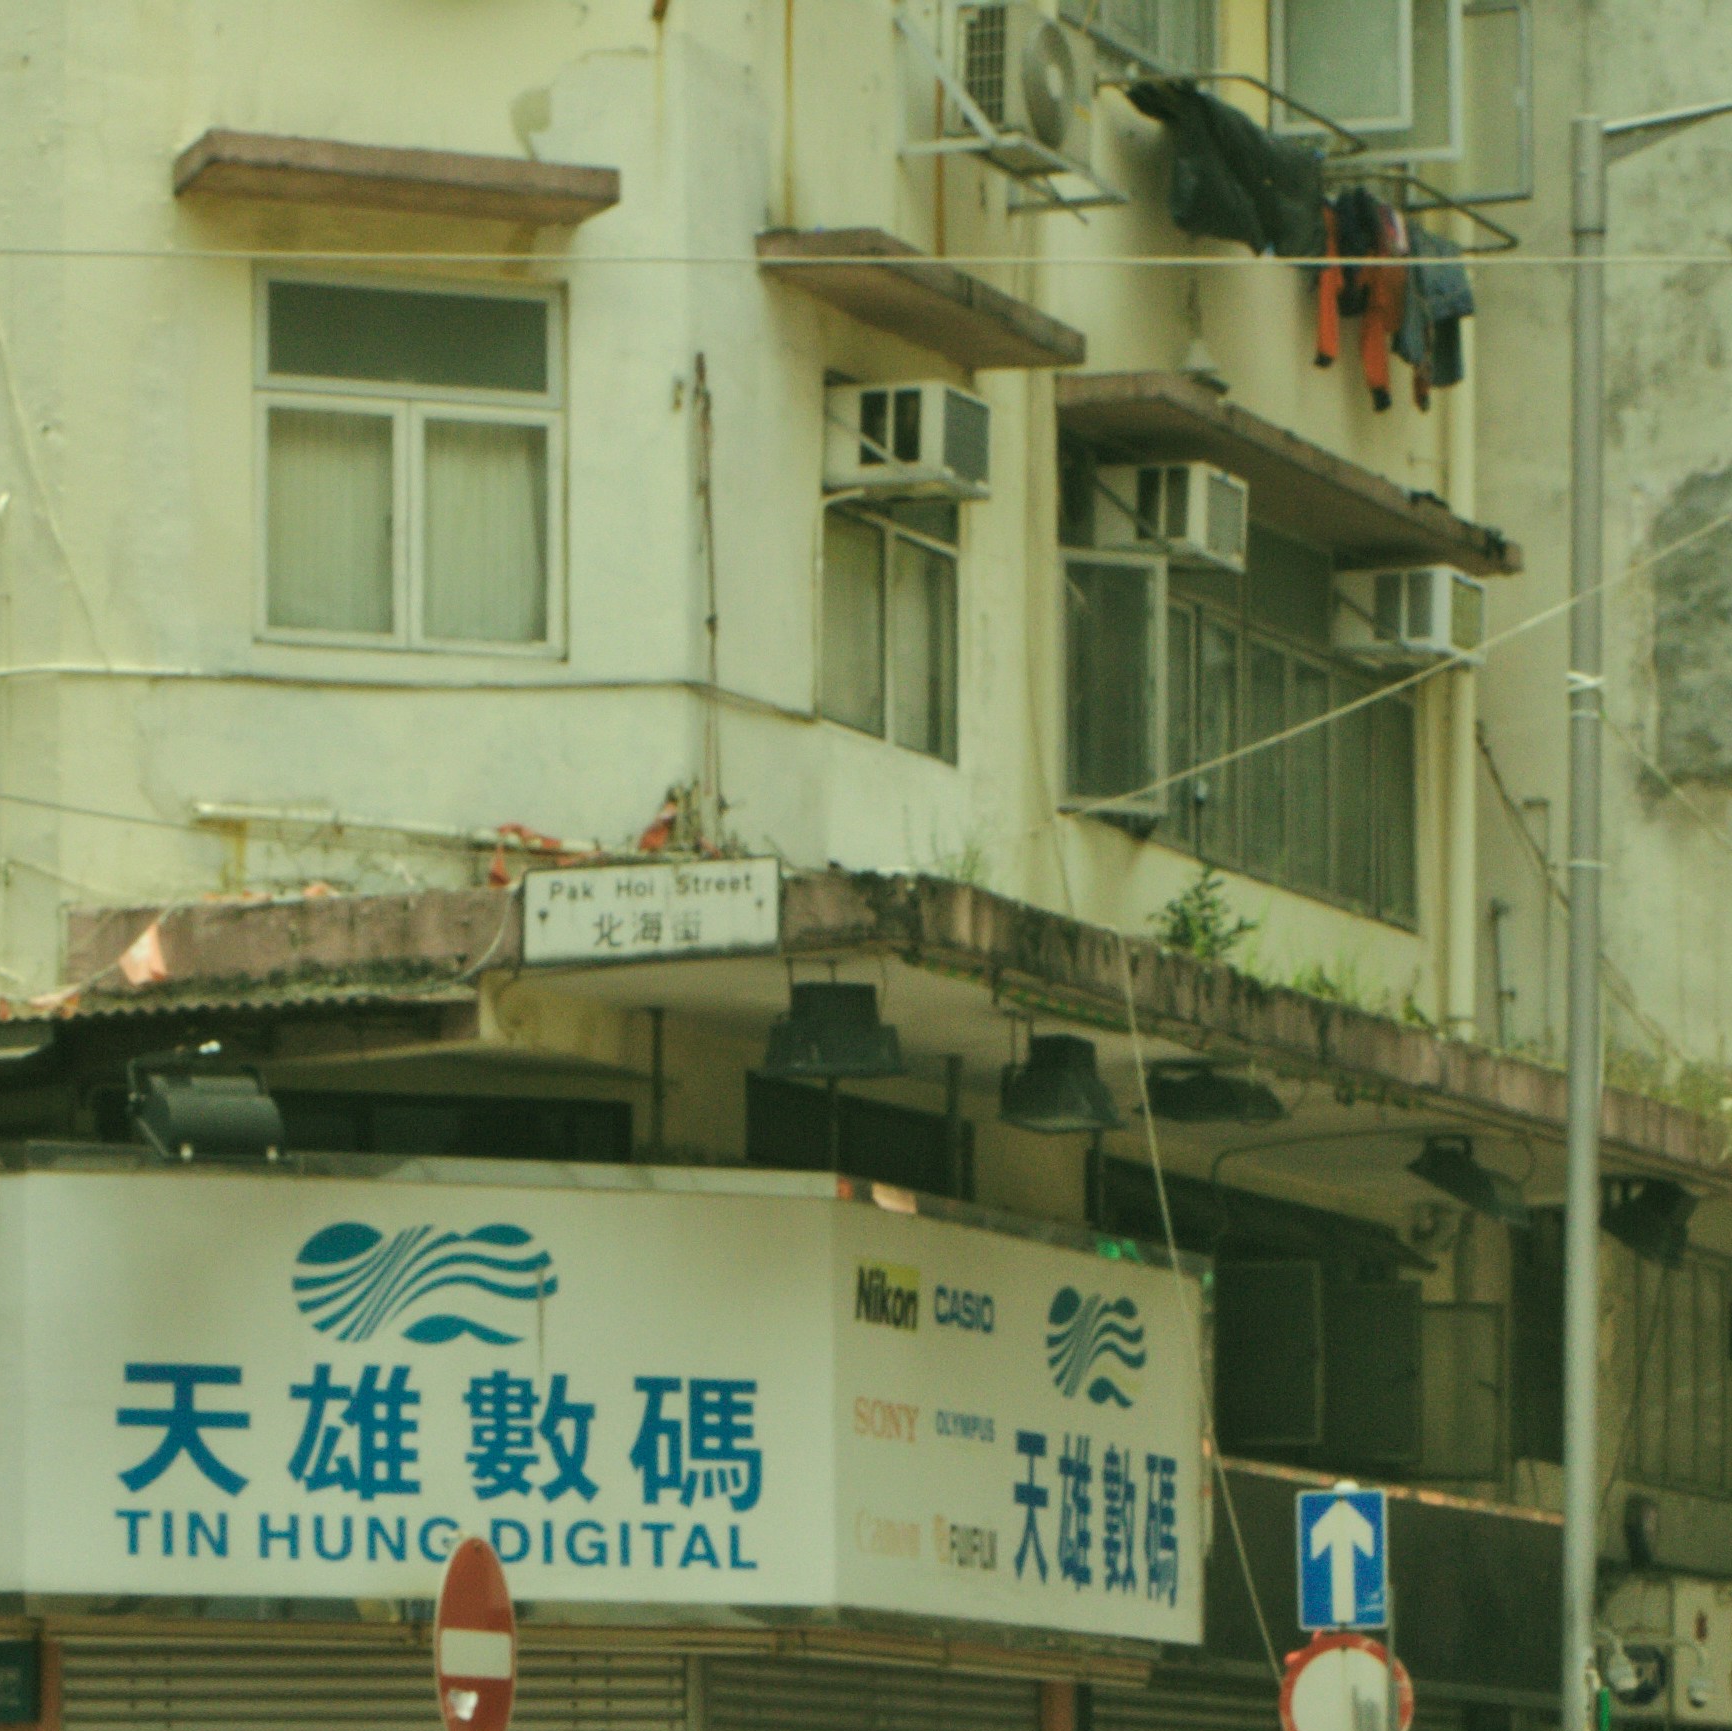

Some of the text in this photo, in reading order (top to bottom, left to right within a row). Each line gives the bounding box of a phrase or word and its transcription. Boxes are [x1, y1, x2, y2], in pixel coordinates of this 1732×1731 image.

[549, 873, 752, 899] Pak Hoi Street
[855, 1265, 919, 1332] Nikon
[933, 1284, 995, 1334] CASIO
[115, 1362, 763, 1511] 天雄數碼
[853, 1395, 920, 1444] SONY
[115, 1510, 758, 1570] TIN HUNG DIGITAL
[1013, 1428, 1179, 1608] 天雄數碼
